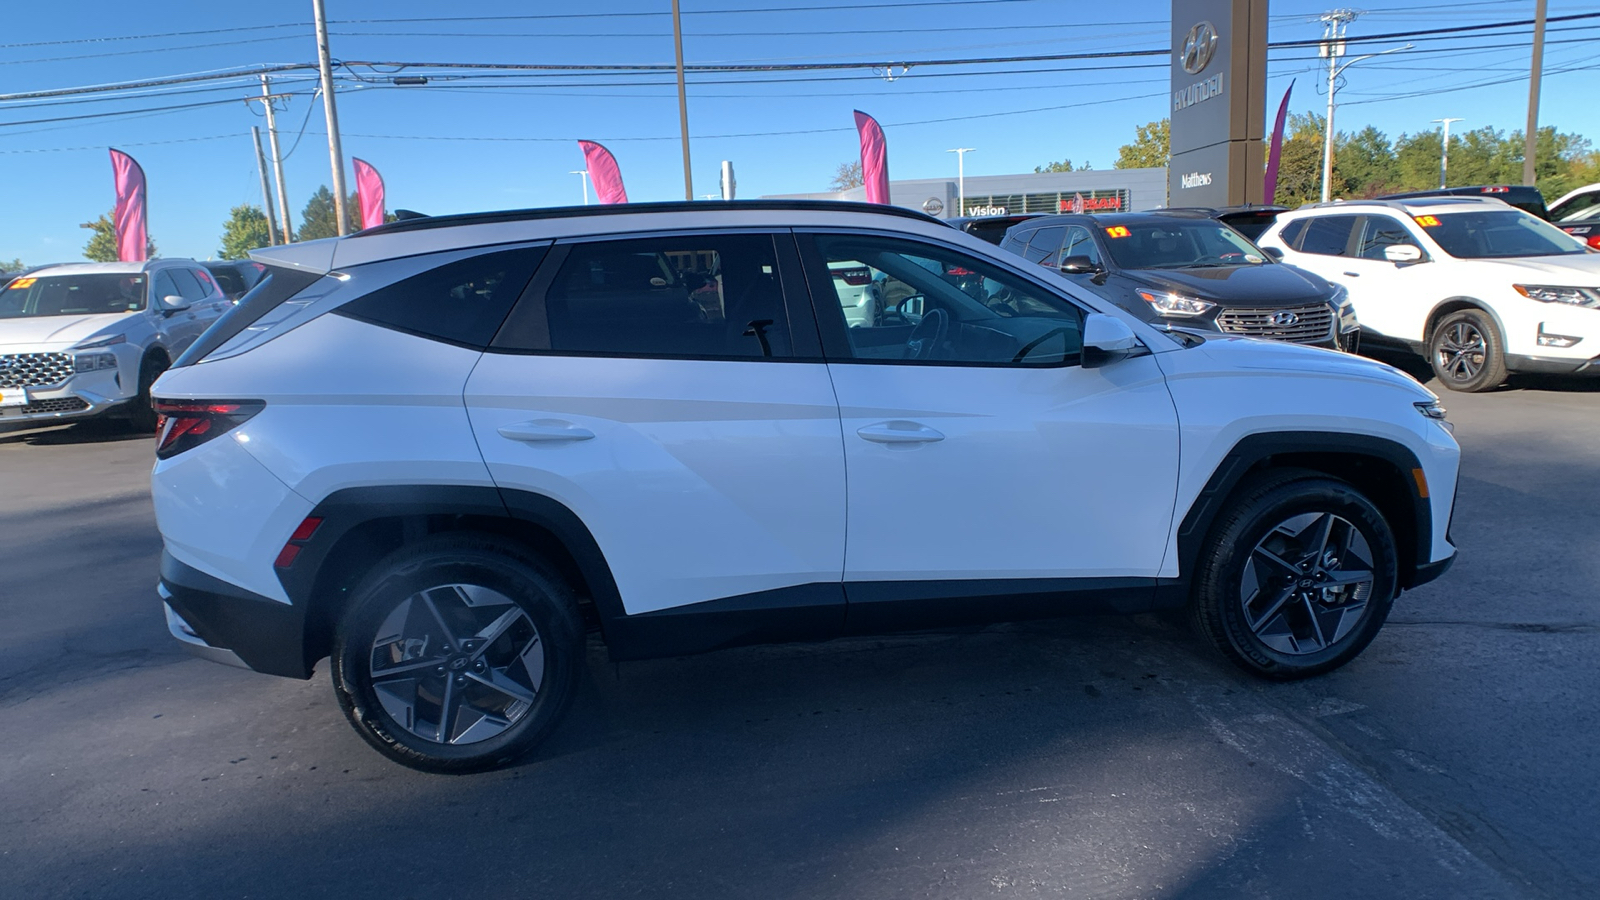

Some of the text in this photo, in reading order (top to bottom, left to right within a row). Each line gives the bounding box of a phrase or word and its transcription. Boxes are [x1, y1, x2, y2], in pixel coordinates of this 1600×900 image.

[1174, 72, 1223, 112] HYUNDAI
[1181, 171, 1212, 189] Matthews
[969, 205, 1006, 216] Vision
[1060, 197, 1121, 211] NSAN
[1416, 216, 1437, 226] 18
[1107, 226, 1126, 237] 19
[1361, 509, 1394, 573] NEXEN
[1227, 611, 1270, 665] ROADIAN
